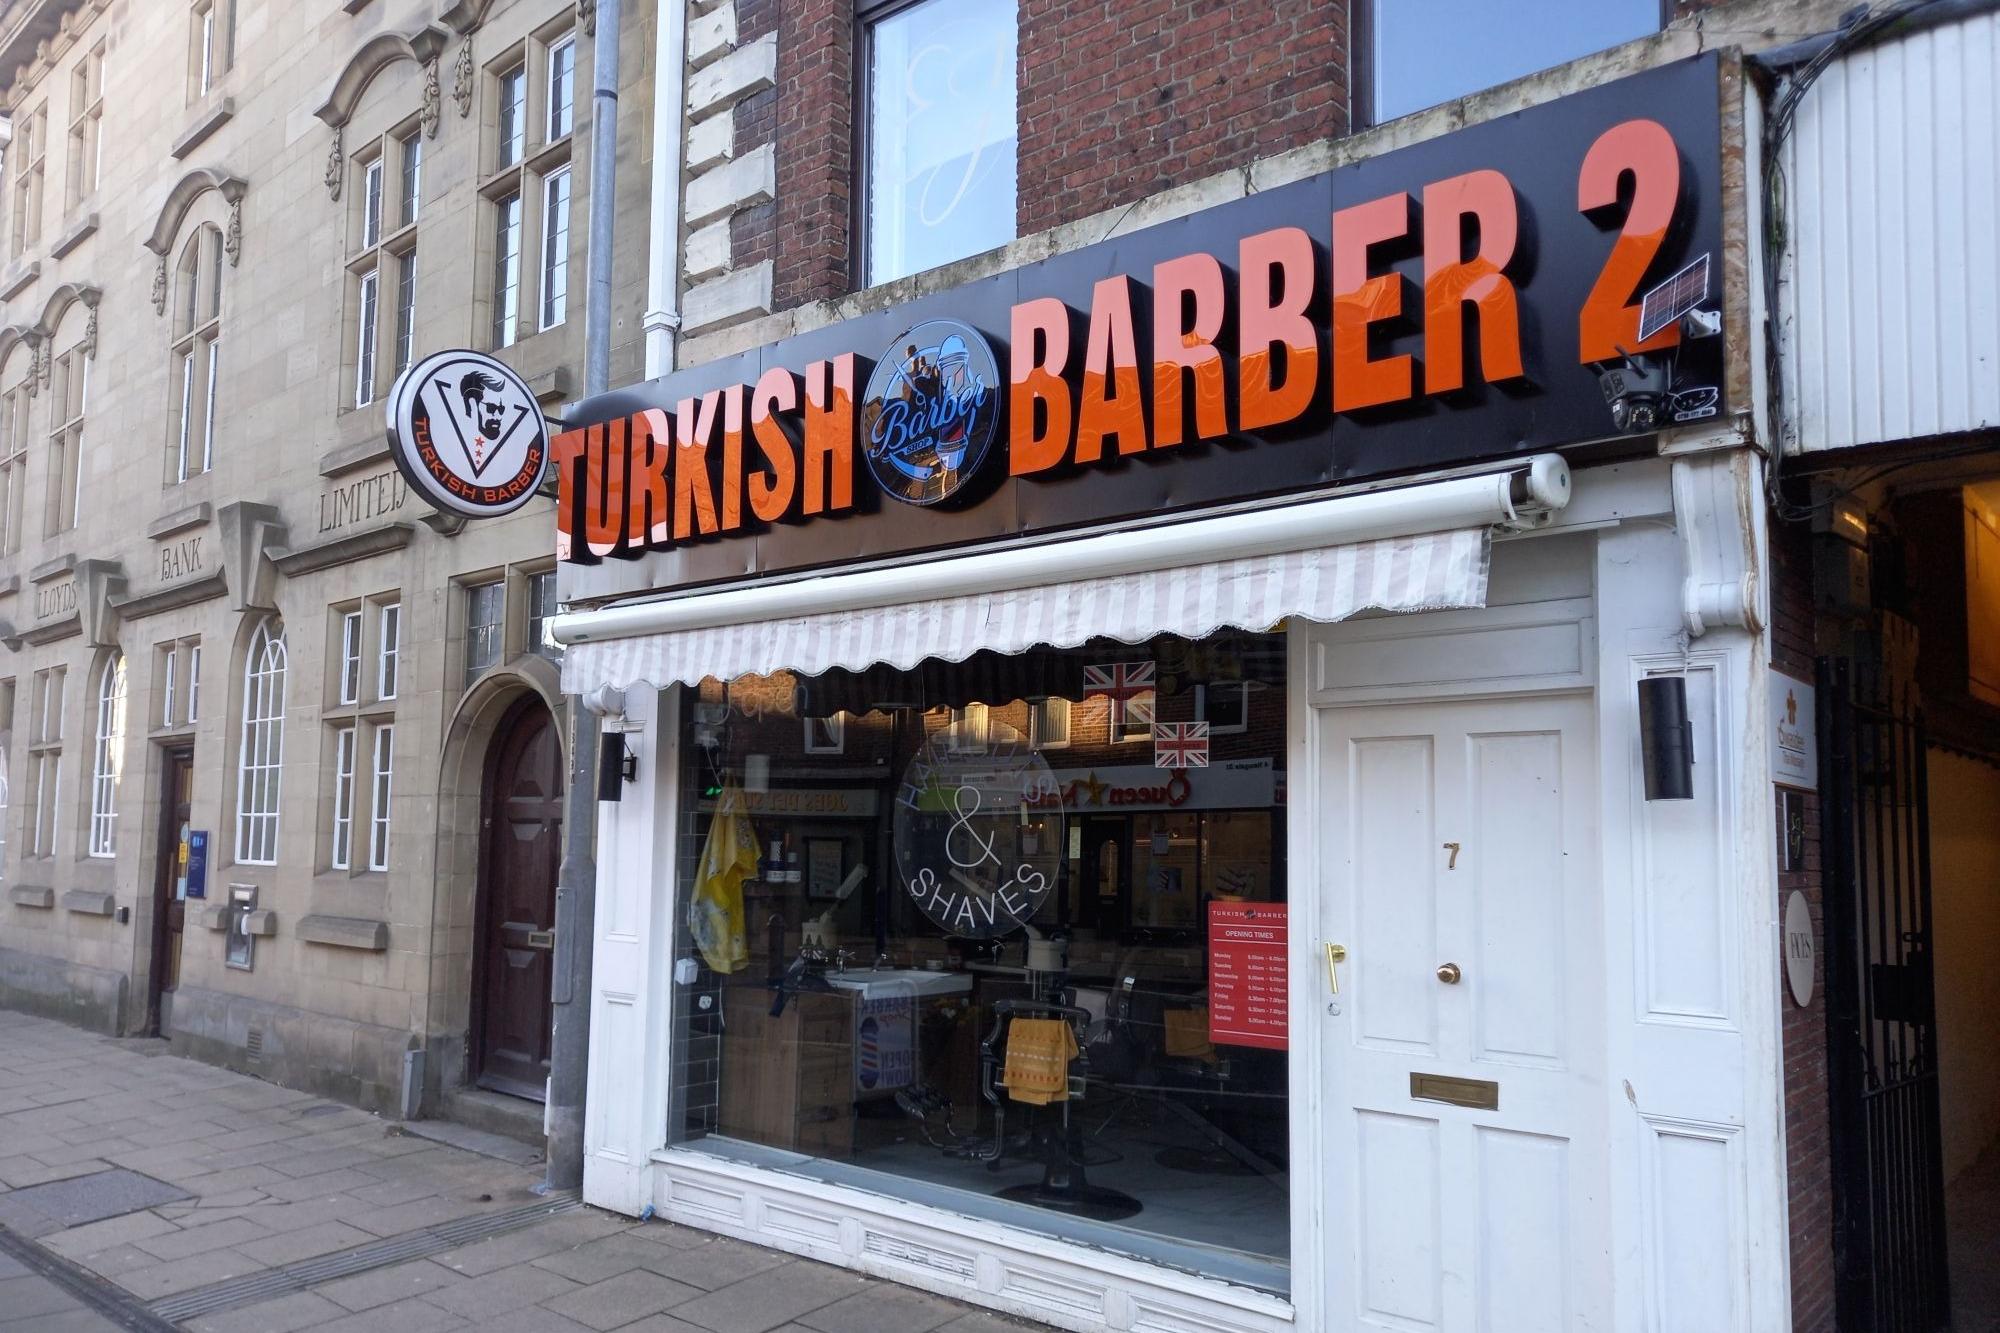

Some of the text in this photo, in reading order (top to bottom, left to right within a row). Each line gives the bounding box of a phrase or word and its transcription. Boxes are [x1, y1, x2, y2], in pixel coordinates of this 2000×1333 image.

[551, 119, 1681, 561] TURKISH BARBER 2
[868, 374, 987, 458] Barber
[906, 437, 930, 455] SHOP
[415, 417, 541, 503] TURKISH BARBER
[37, 580, 77, 620] LLOYDS
[161, 536, 202, 582] BANK
[945, 784, 1002, 868] &
[1443, 842, 1460, 871] 7
[910, 863, 1046, 930] SHAVES
[1225, 930, 1274, 939] OPENING TIMES
